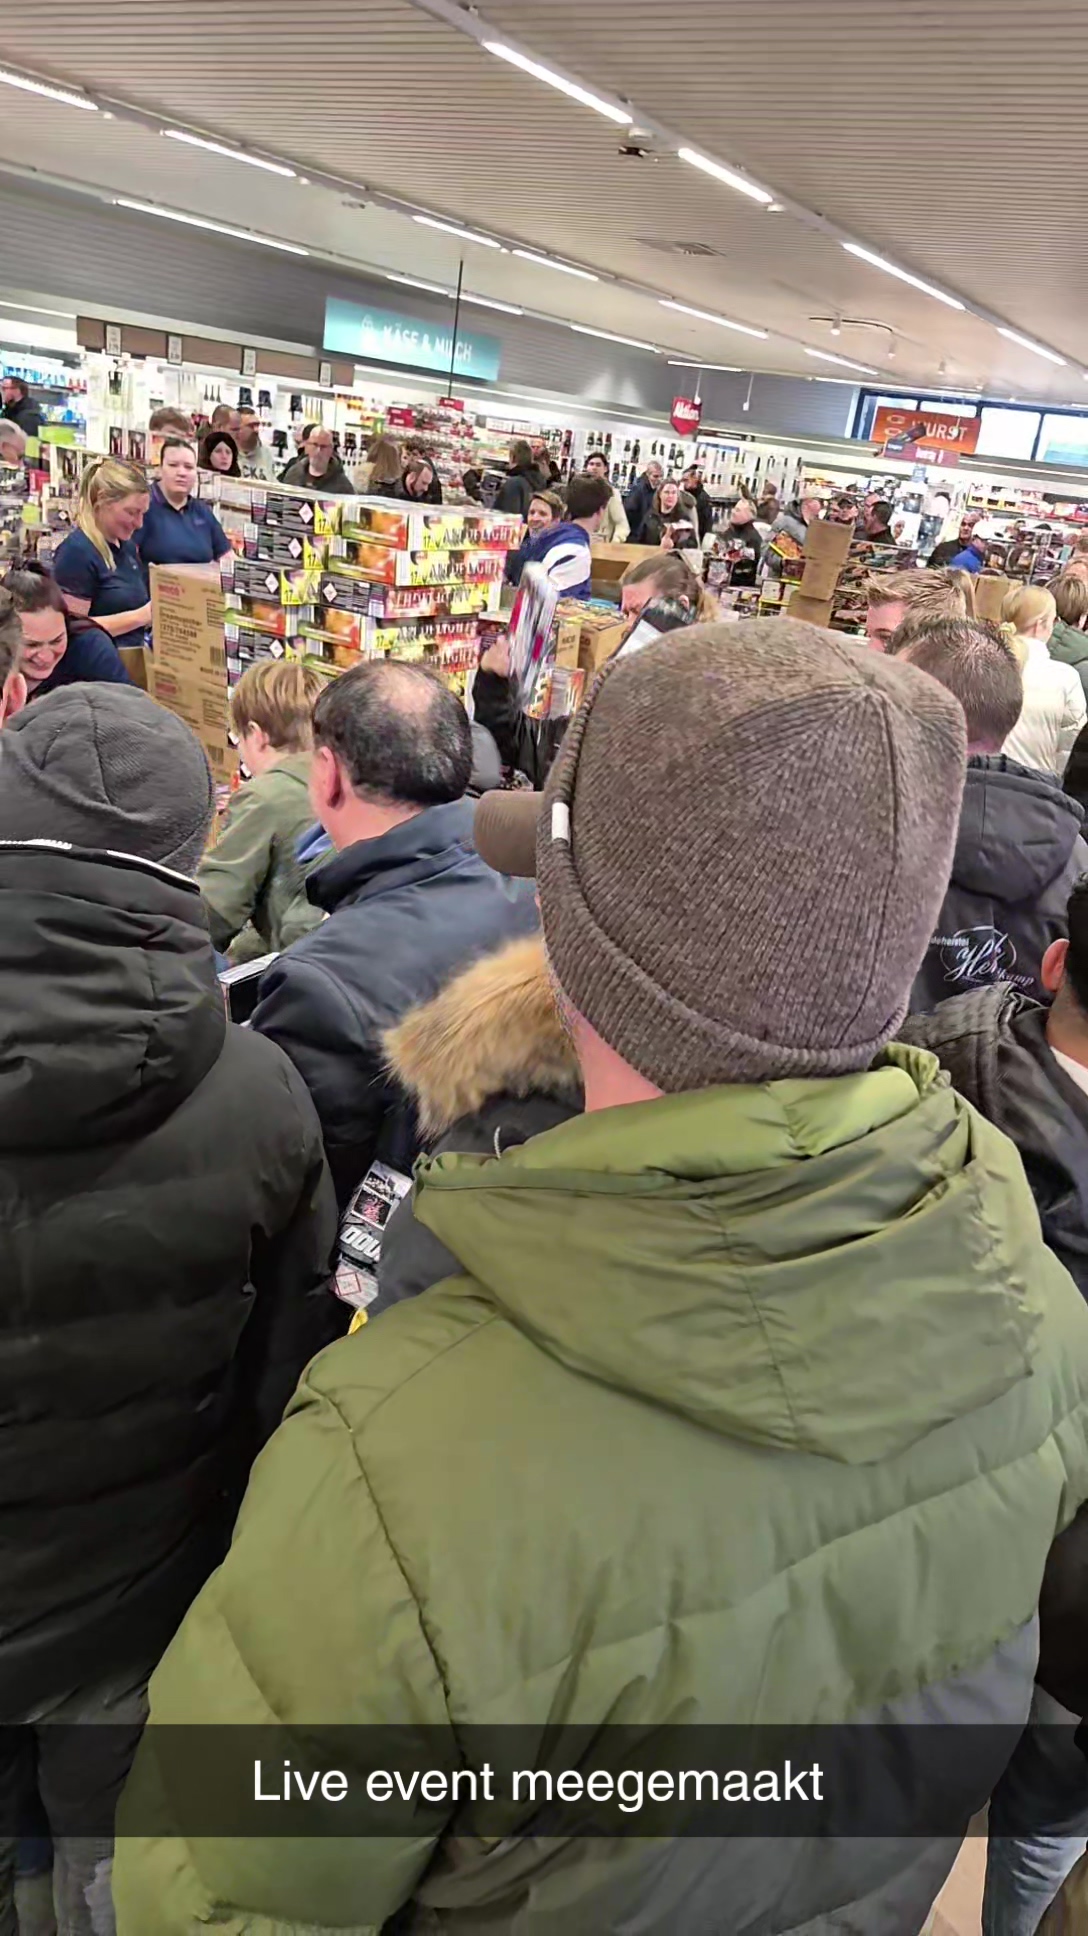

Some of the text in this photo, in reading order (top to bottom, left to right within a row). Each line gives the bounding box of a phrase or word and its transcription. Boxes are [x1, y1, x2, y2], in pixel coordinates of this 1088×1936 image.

[382, 323, 473, 362] KÄSE & MILCH
[911, 420, 968, 442] URST
